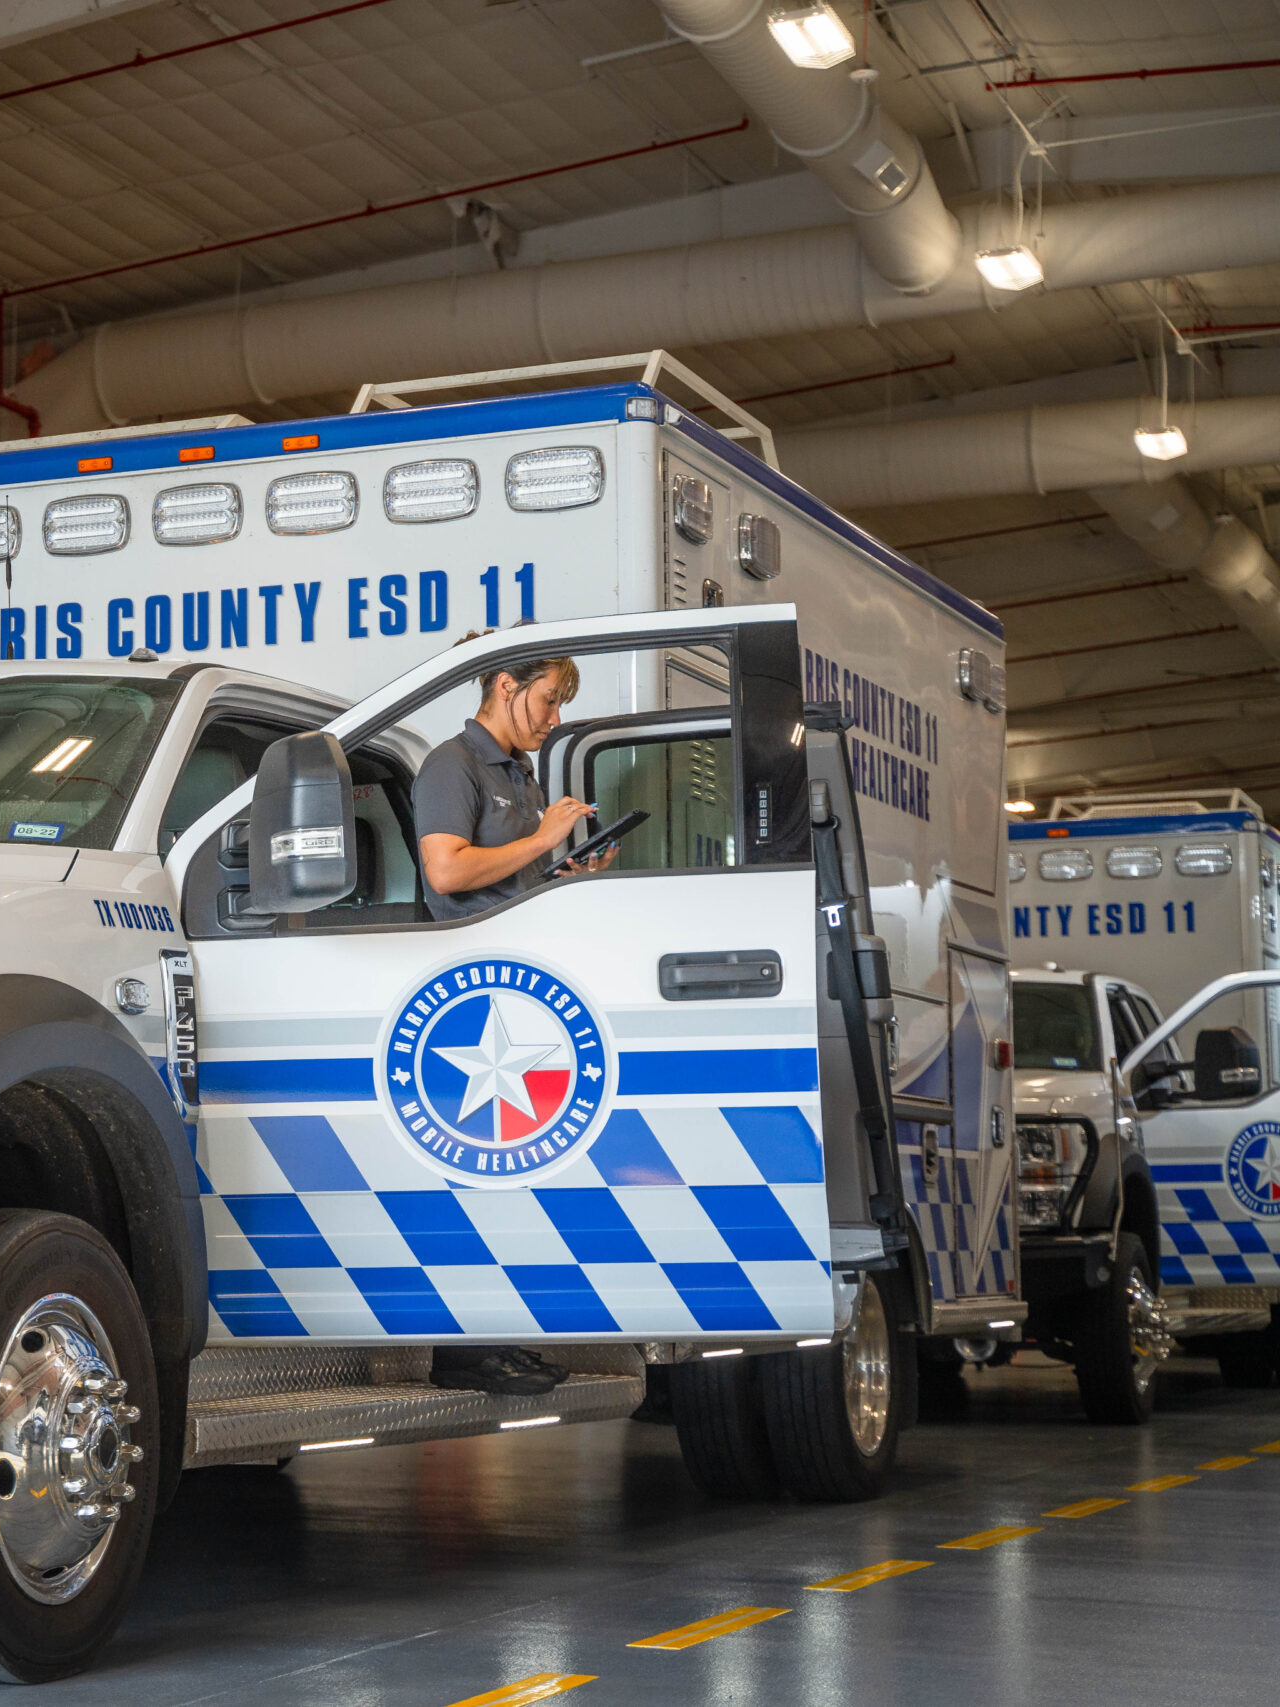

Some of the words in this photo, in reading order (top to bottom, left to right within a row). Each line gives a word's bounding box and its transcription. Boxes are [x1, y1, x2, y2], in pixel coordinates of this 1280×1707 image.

[107, 581, 321, 658] COUNTY
[348, 570, 448, 639] ESD
[480, 562, 535, 627] 11
[805, 648, 839, 702] RRIS
[843, 668, 895, 744] COUNTY
[899, 697, 921, 756] ESD
[926, 711, 938, 766] 11
[852, 736, 930, 822] HEALTHCARE
[94, 899, 116, 927] TX
[114, 902, 175, 932] 1001036
[1013, 905, 1073, 938] NTY
[1088, 903, 1146, 935] ESD
[1163, 901, 1195, 933] 11
[174, 960, 187, 968] XLT
[394, 982, 449, 1053] HARRIS
[454, 966, 540, 990] COUNTY
[544, 984, 581, 1021] ESD
[575, 1027, 597, 1050] 11
[400, 1101, 465, 1164] MOBILE
[477, 1097, 594, 1172] HEALTHCARE
